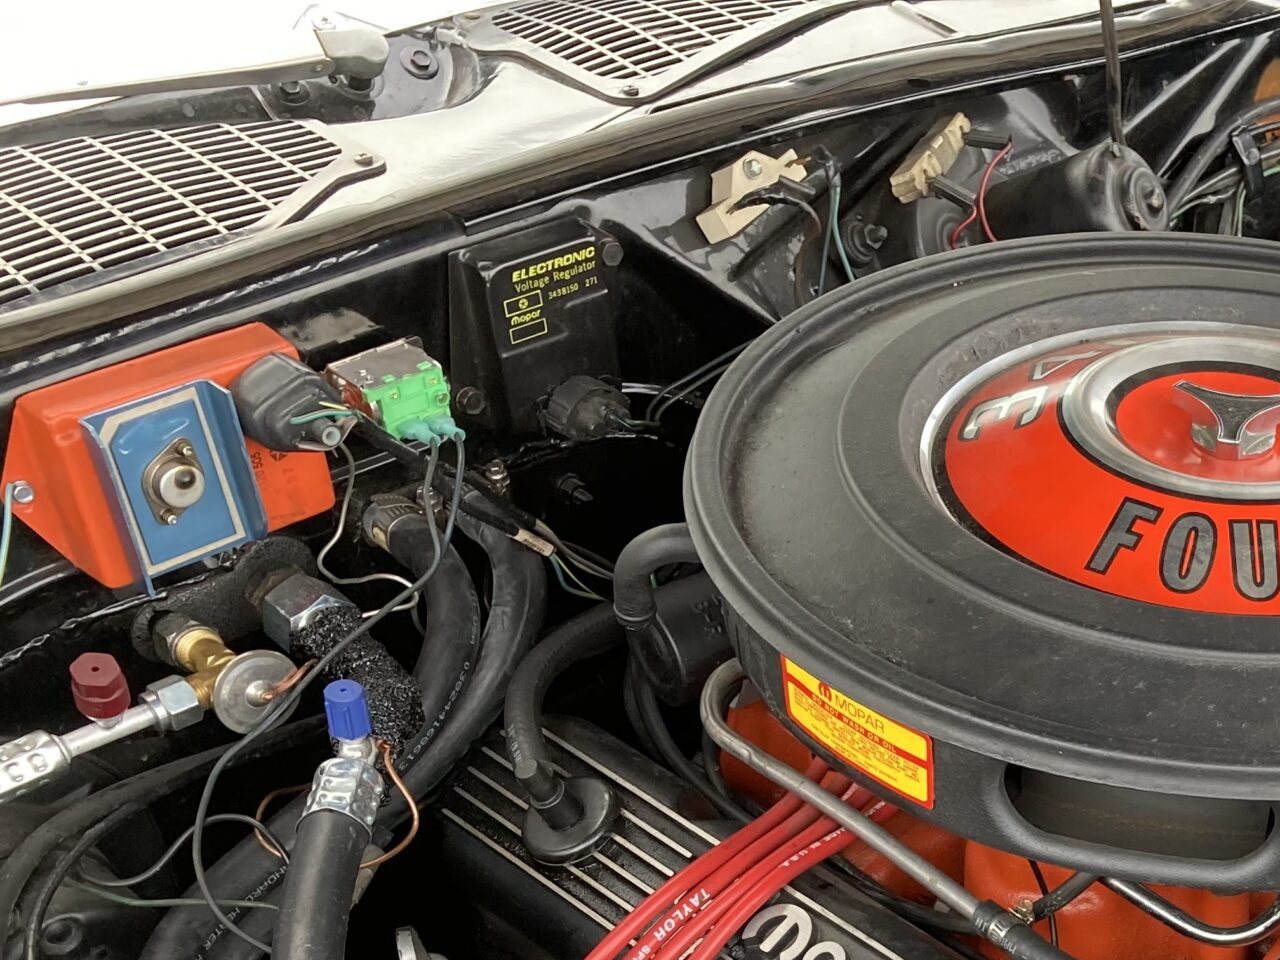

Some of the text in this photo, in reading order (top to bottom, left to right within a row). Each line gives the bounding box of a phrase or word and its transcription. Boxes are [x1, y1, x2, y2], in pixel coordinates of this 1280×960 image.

[512, 246, 595, 283] ELECTRONIC
[515, 260, 596, 293] Voltage Regulator
[548, 276, 598, 300] 3438150 271
[511, 309, 541, 326] Mopar
[812, 693, 897, 753] DO NOT WASH OR OIL
[835, 694, 886, 734] MOPAR
[653, 887, 711, 942] TAYLOR
[974, 916, 987, 932] IN
